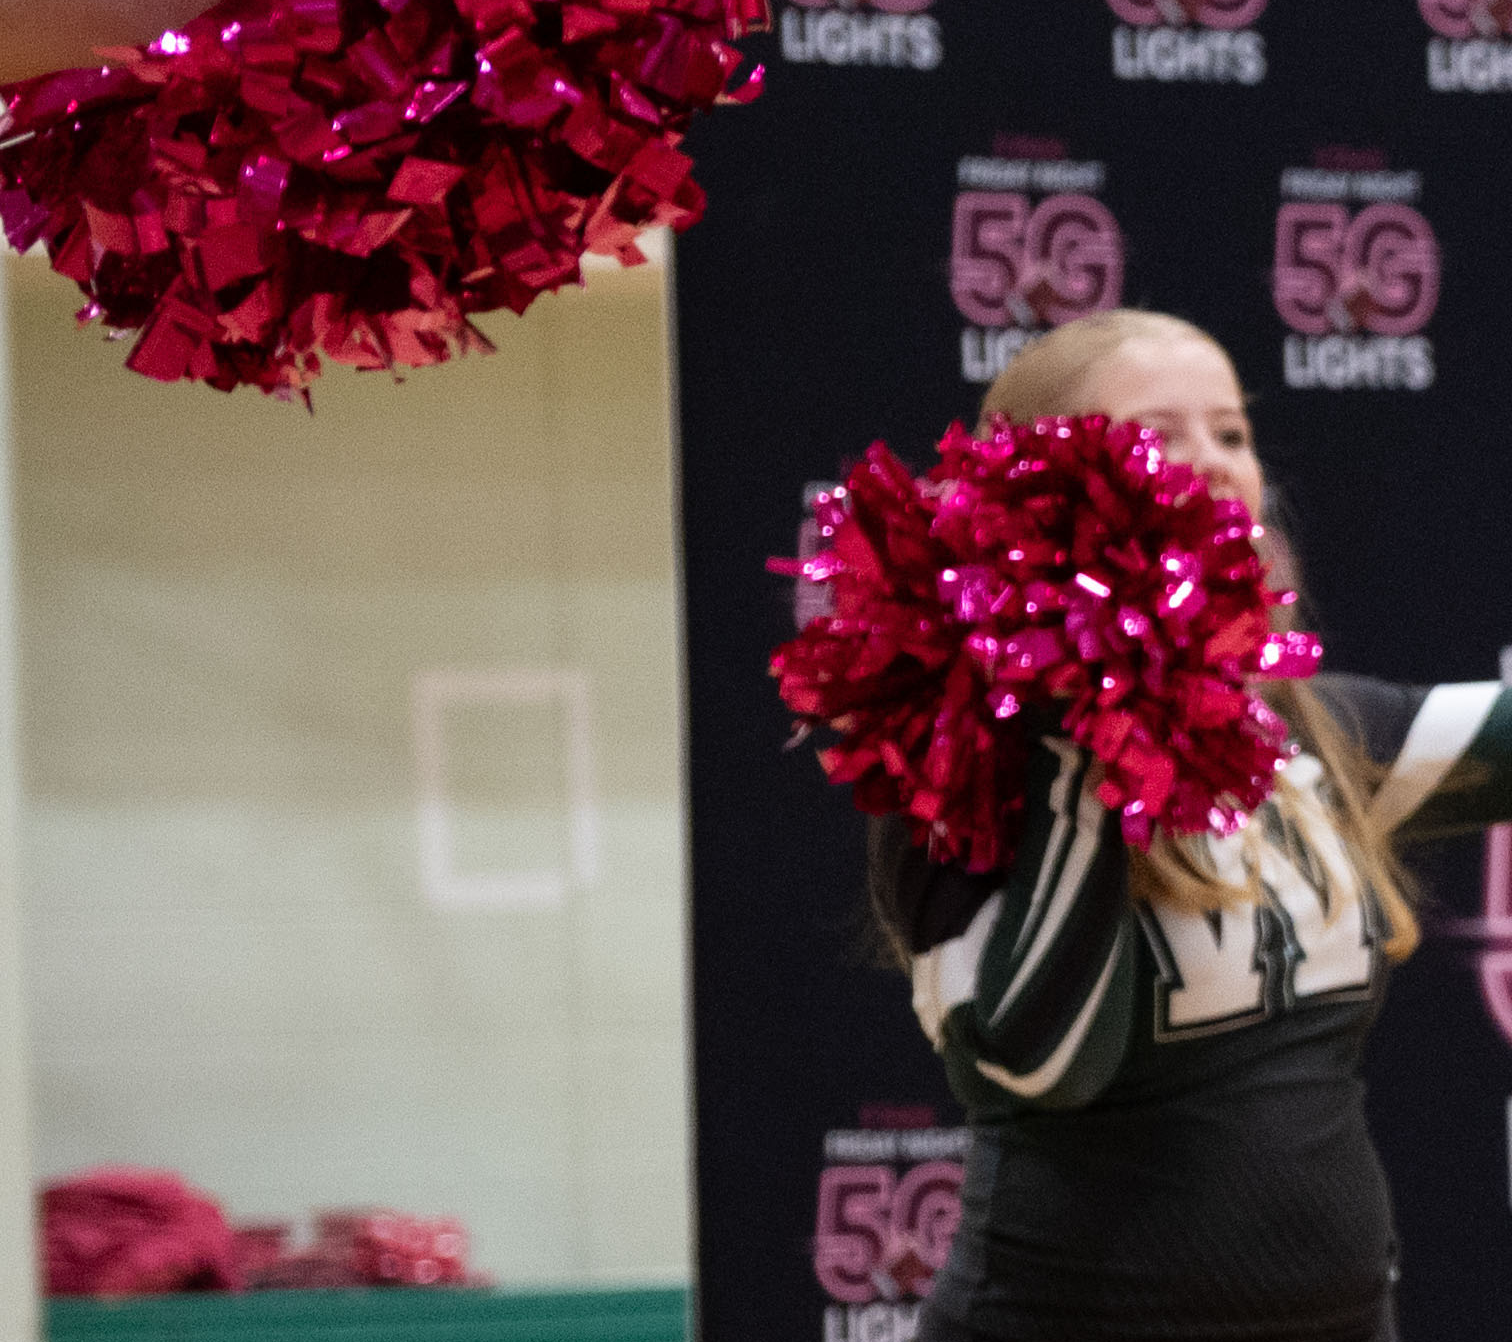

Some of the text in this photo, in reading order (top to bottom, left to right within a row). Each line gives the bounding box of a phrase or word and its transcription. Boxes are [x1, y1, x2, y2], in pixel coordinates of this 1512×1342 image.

[780, 4, 942, 68] LIGHTS
[1112, 28, 1266, 83] LIGHTS
[951, 192, 1123, 329] 5G
[1273, 203, 1438, 335] 5G
[1283, 336, 1434, 390] LIGHTS
